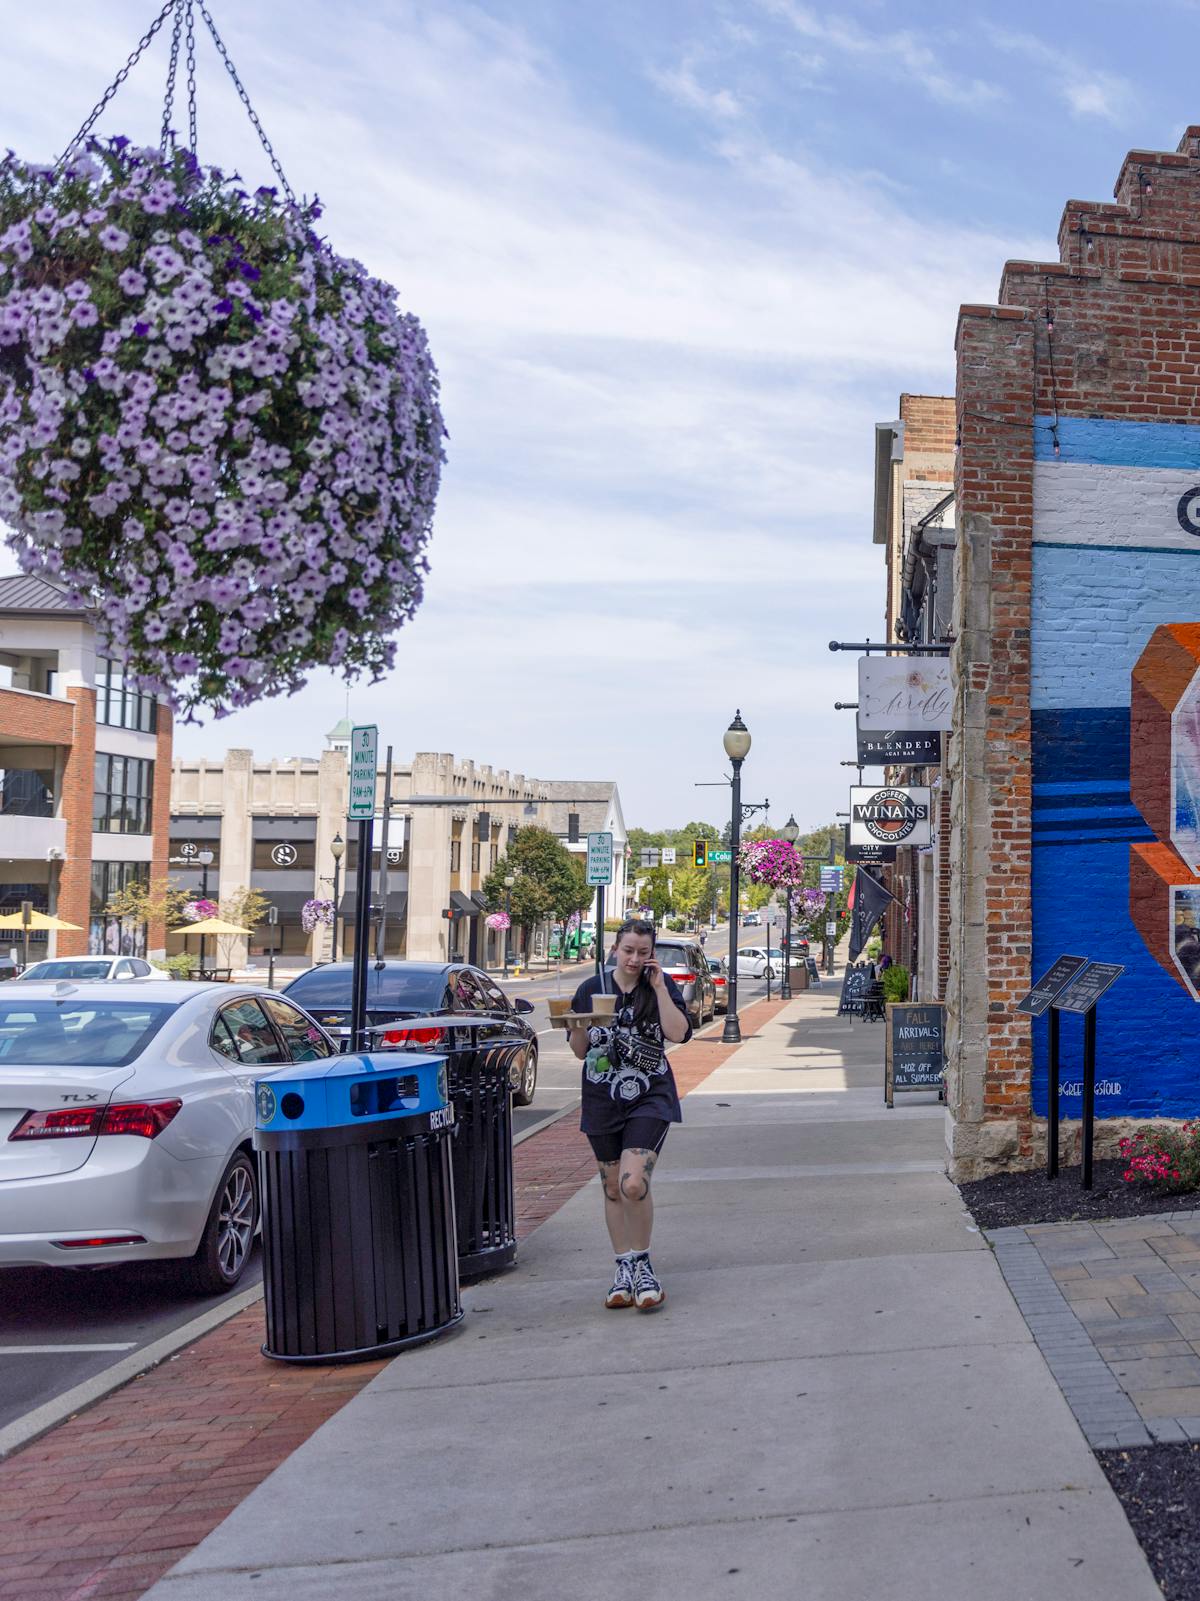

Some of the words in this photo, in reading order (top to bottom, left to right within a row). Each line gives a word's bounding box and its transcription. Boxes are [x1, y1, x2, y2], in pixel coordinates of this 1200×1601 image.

[867, 741, 932, 750] BLENDED
[354, 750, 374, 764] MINUTE
[354, 769, 374, 781] PARKING
[874, 789, 908, 802] COFFEES
[856, 805, 926, 818] WINANS
[867, 822, 914, 841] CHOCOLATES
[591, 846, 609, 854] MINUTE
[590, 856, 610, 864] PARKING
[715, 852, 732, 861] Colu
[907, 1012, 930, 1025] FALL
[898, 1027, 940, 1039] ARRIVALS
[900, 1063, 915, 1073] 40%
[918, 1063, 932, 1072] OFF
[895, 1074, 907, 1084] ALL
[911, 1073, 940, 1084] SUMMER
[61, 1094, 98, 1102] TLX
